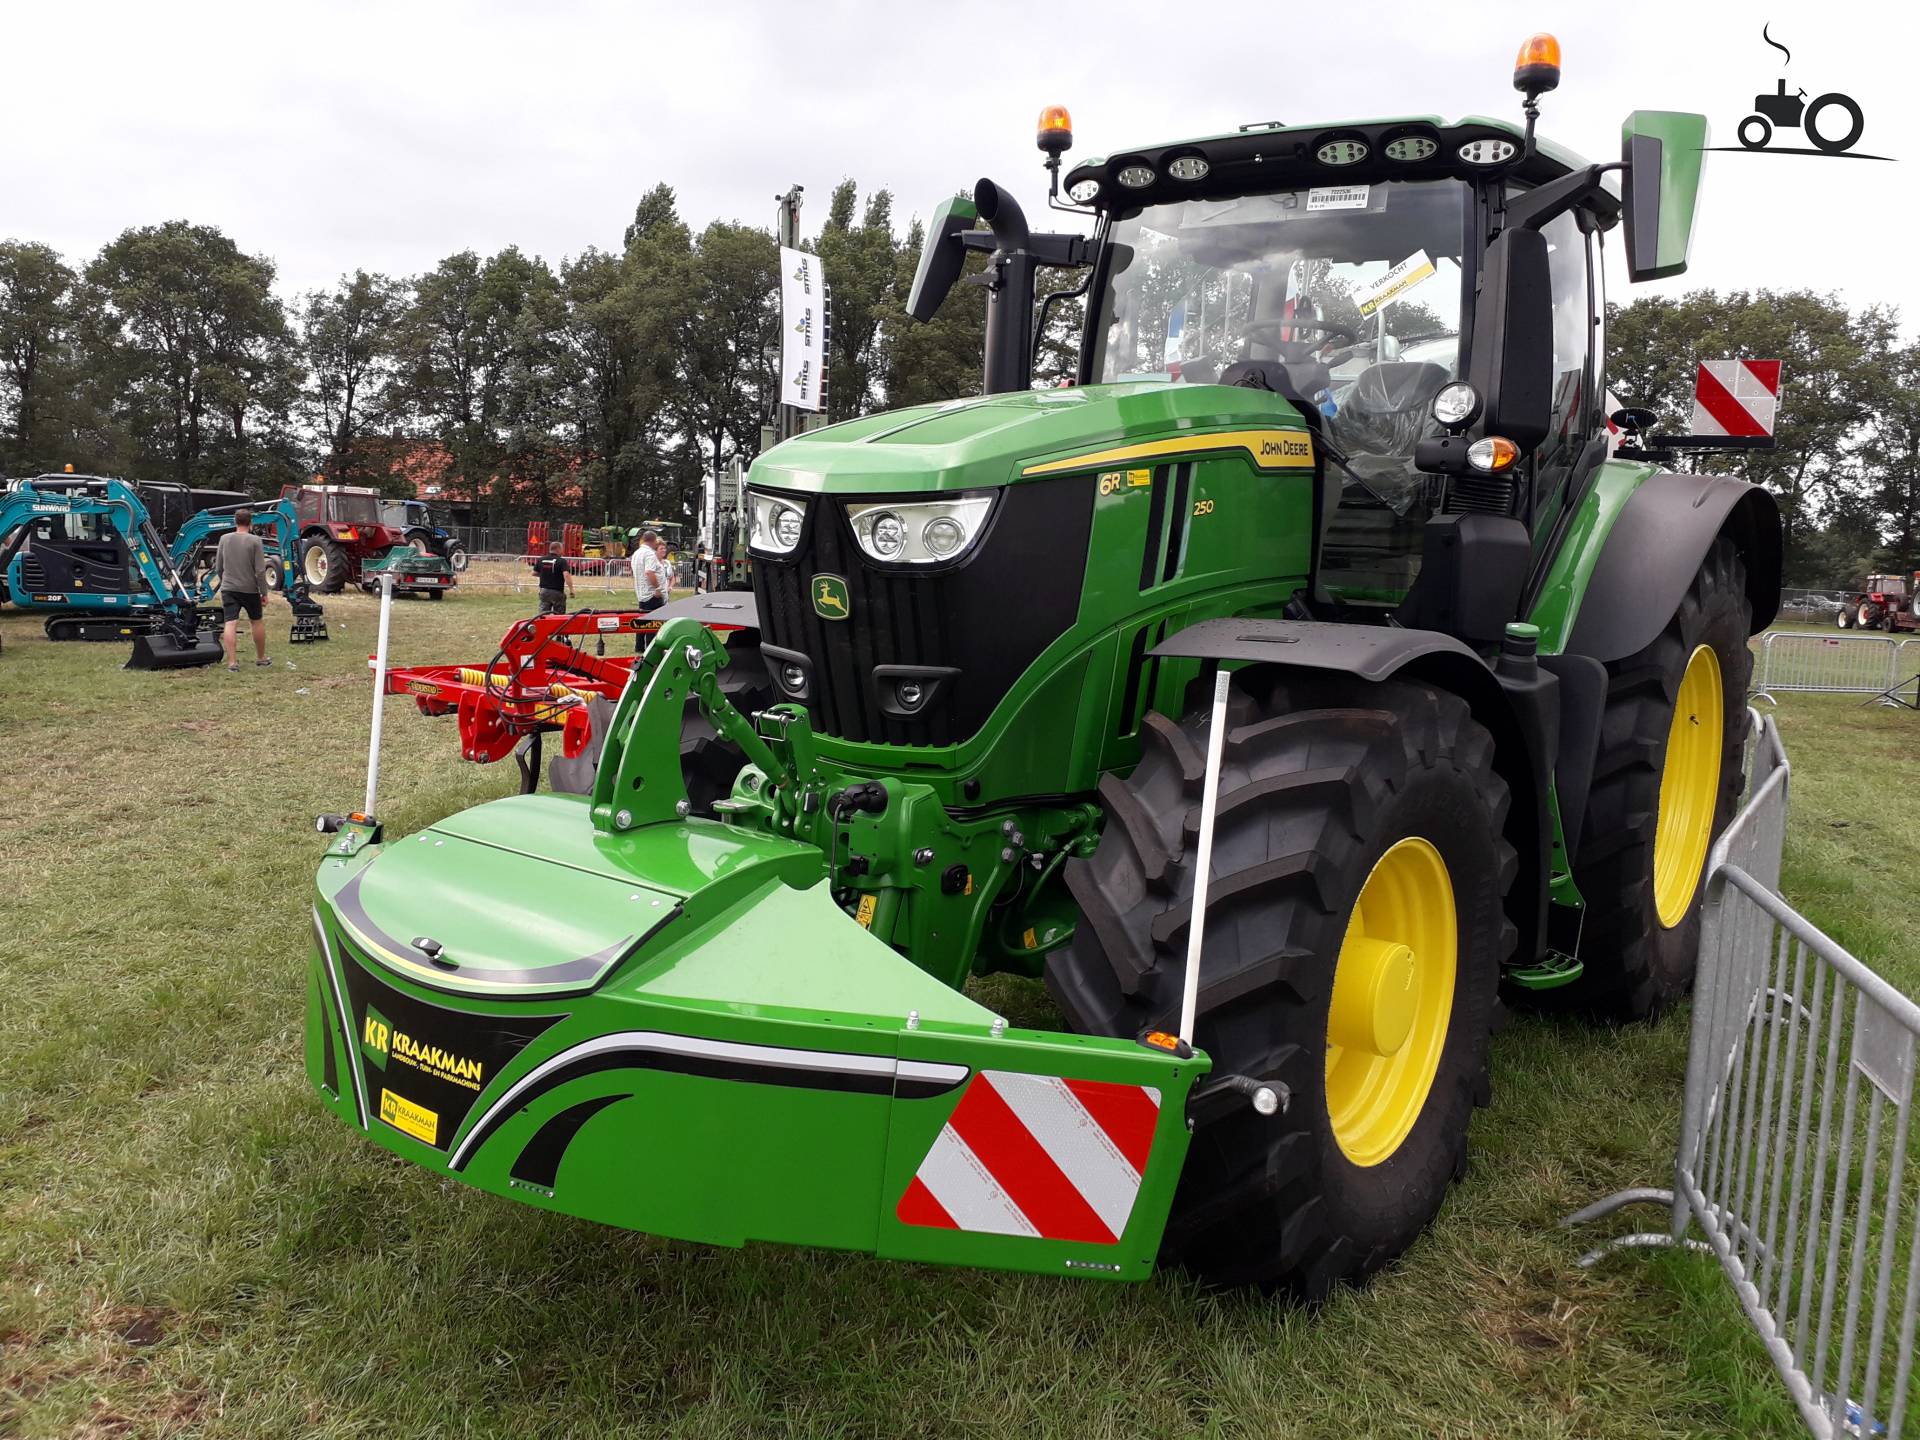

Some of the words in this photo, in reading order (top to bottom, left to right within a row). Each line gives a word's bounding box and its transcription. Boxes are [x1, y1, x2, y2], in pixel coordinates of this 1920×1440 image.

[1369, 262, 1409, 290] VERKOCHT
[1260, 439, 1283, 456] JOHN
[1283, 439, 1309, 456] DEERE
[1099, 472, 1121, 497] 6R
[1193, 499, 1214, 517] 250
[365, 1017, 388, 1053] KR
[392, 1030, 483, 1082] KRAAKMAN
